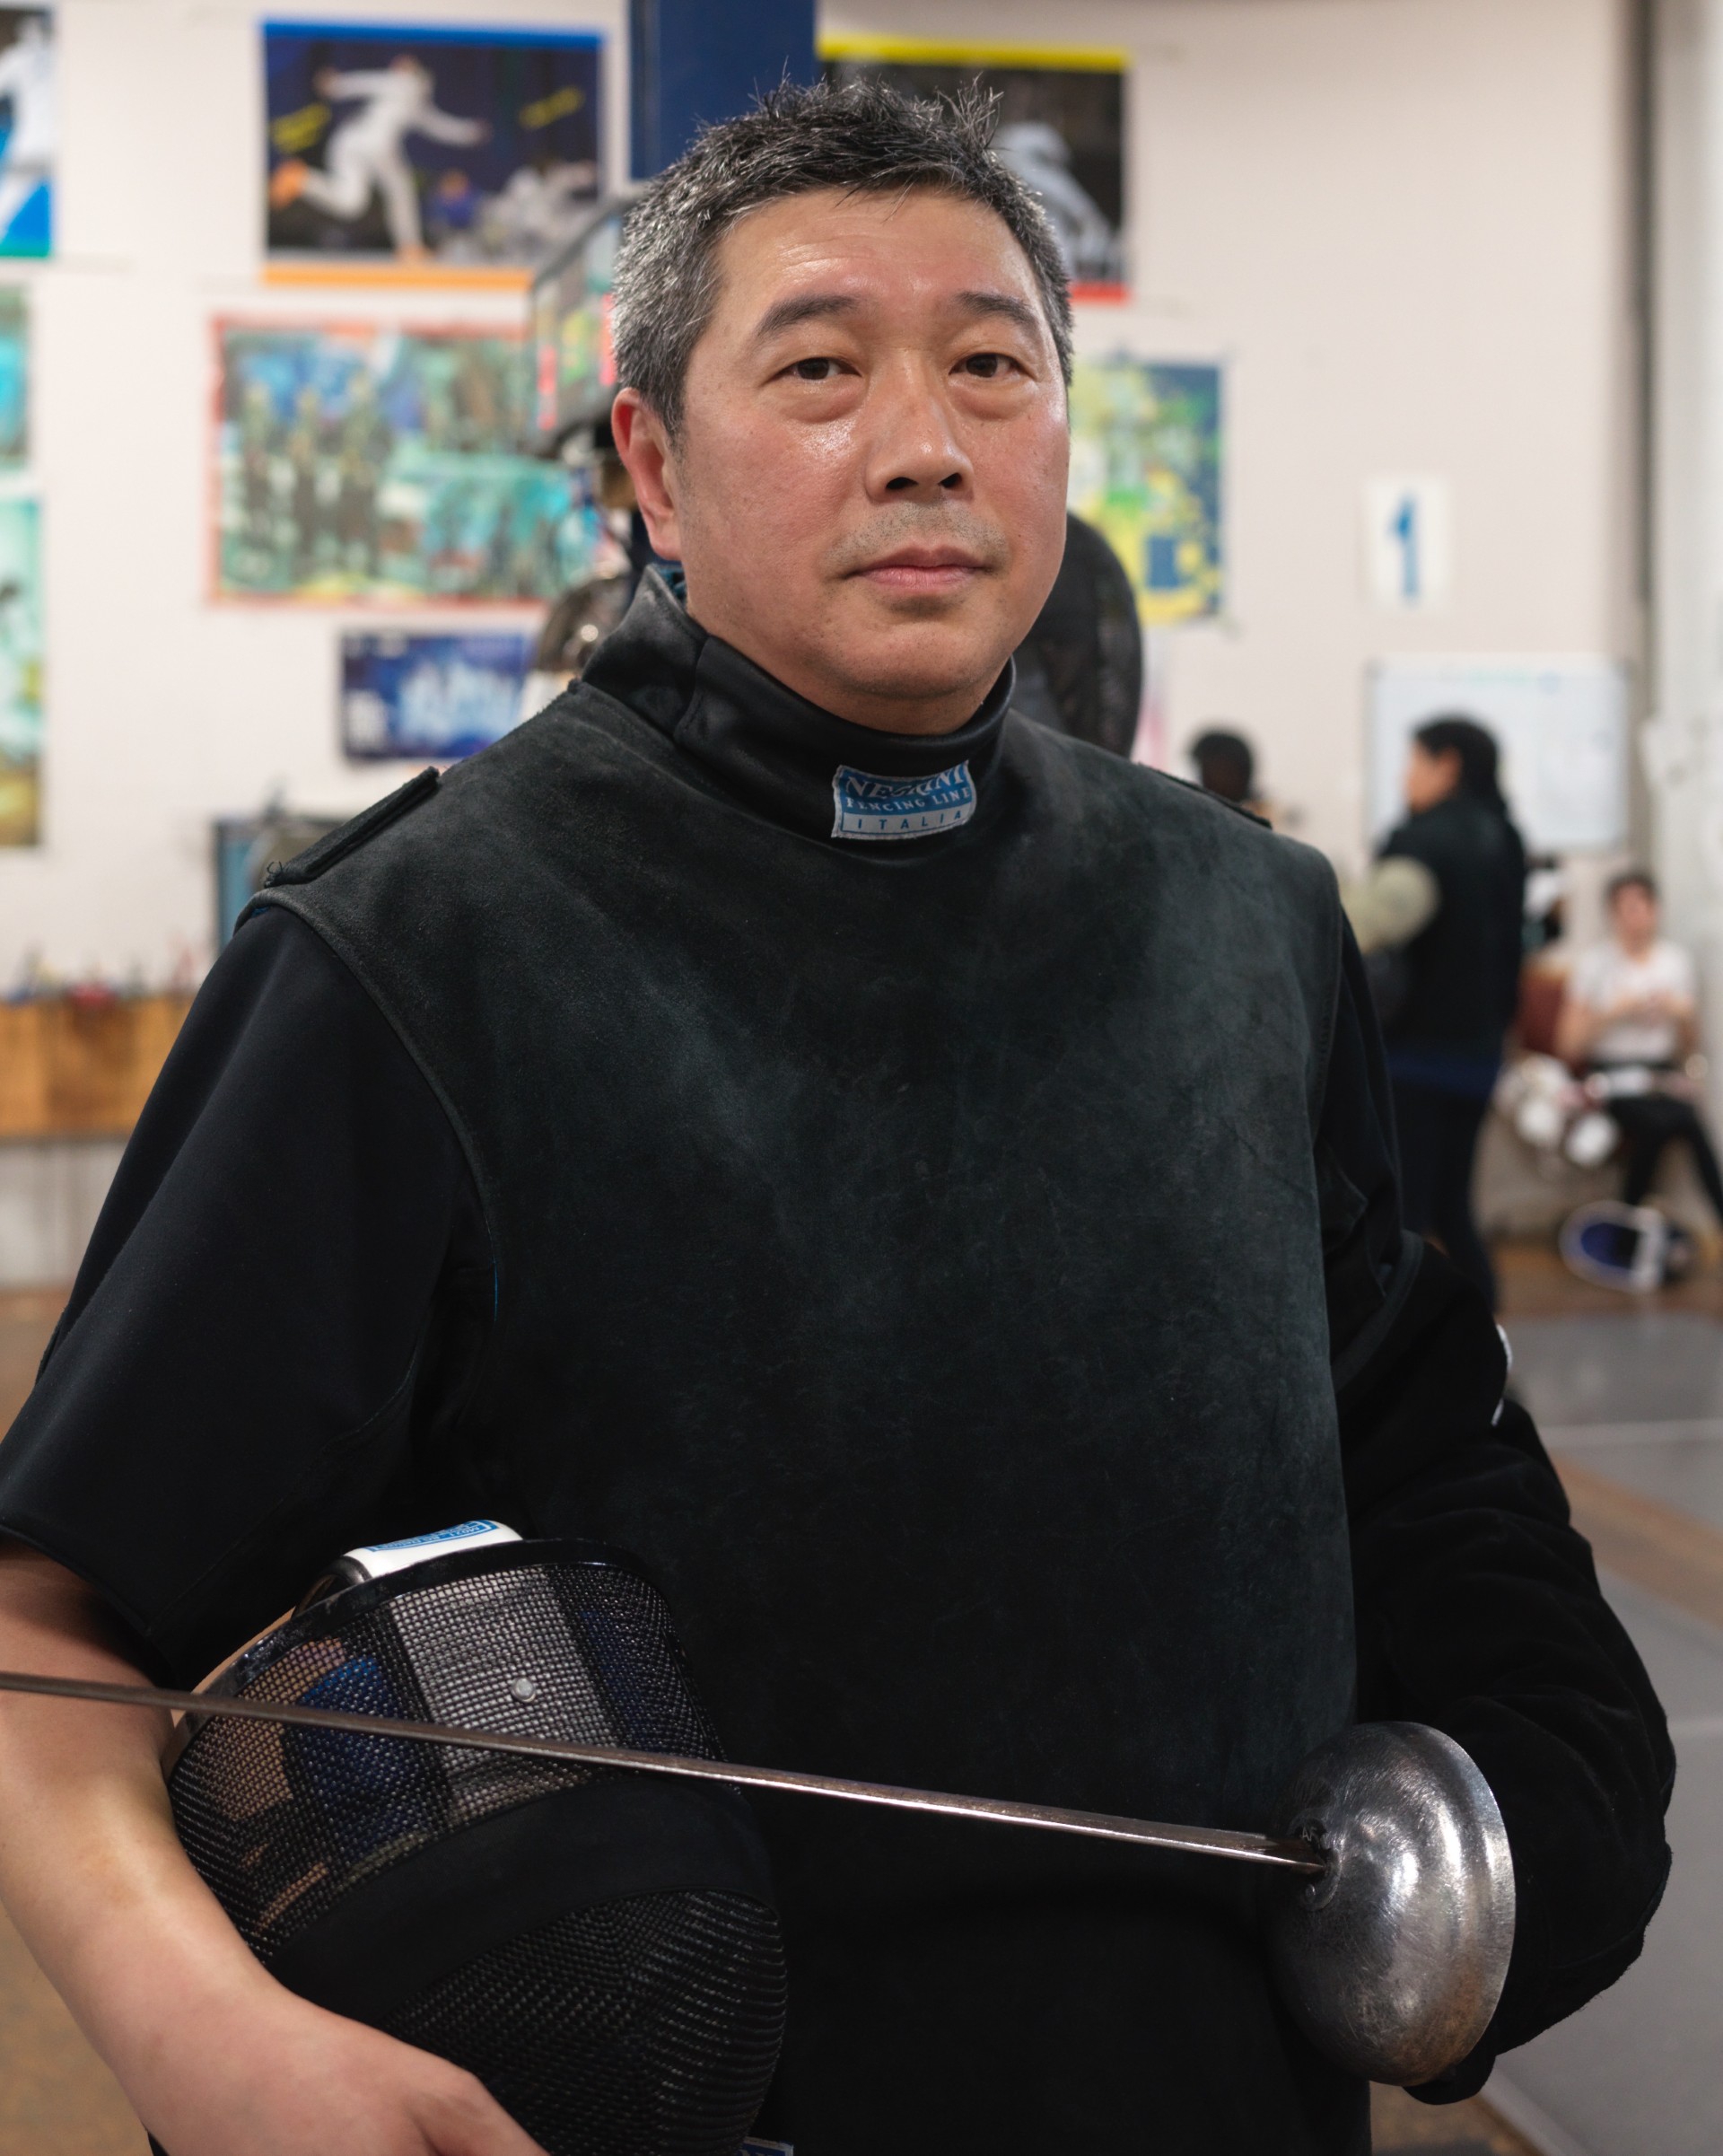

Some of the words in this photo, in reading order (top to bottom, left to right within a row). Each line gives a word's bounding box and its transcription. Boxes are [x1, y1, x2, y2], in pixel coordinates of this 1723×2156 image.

[845, 796, 925, 811] FENCING
[932, 786, 971, 805] LINE
[857, 810, 962, 829] ITALIA
